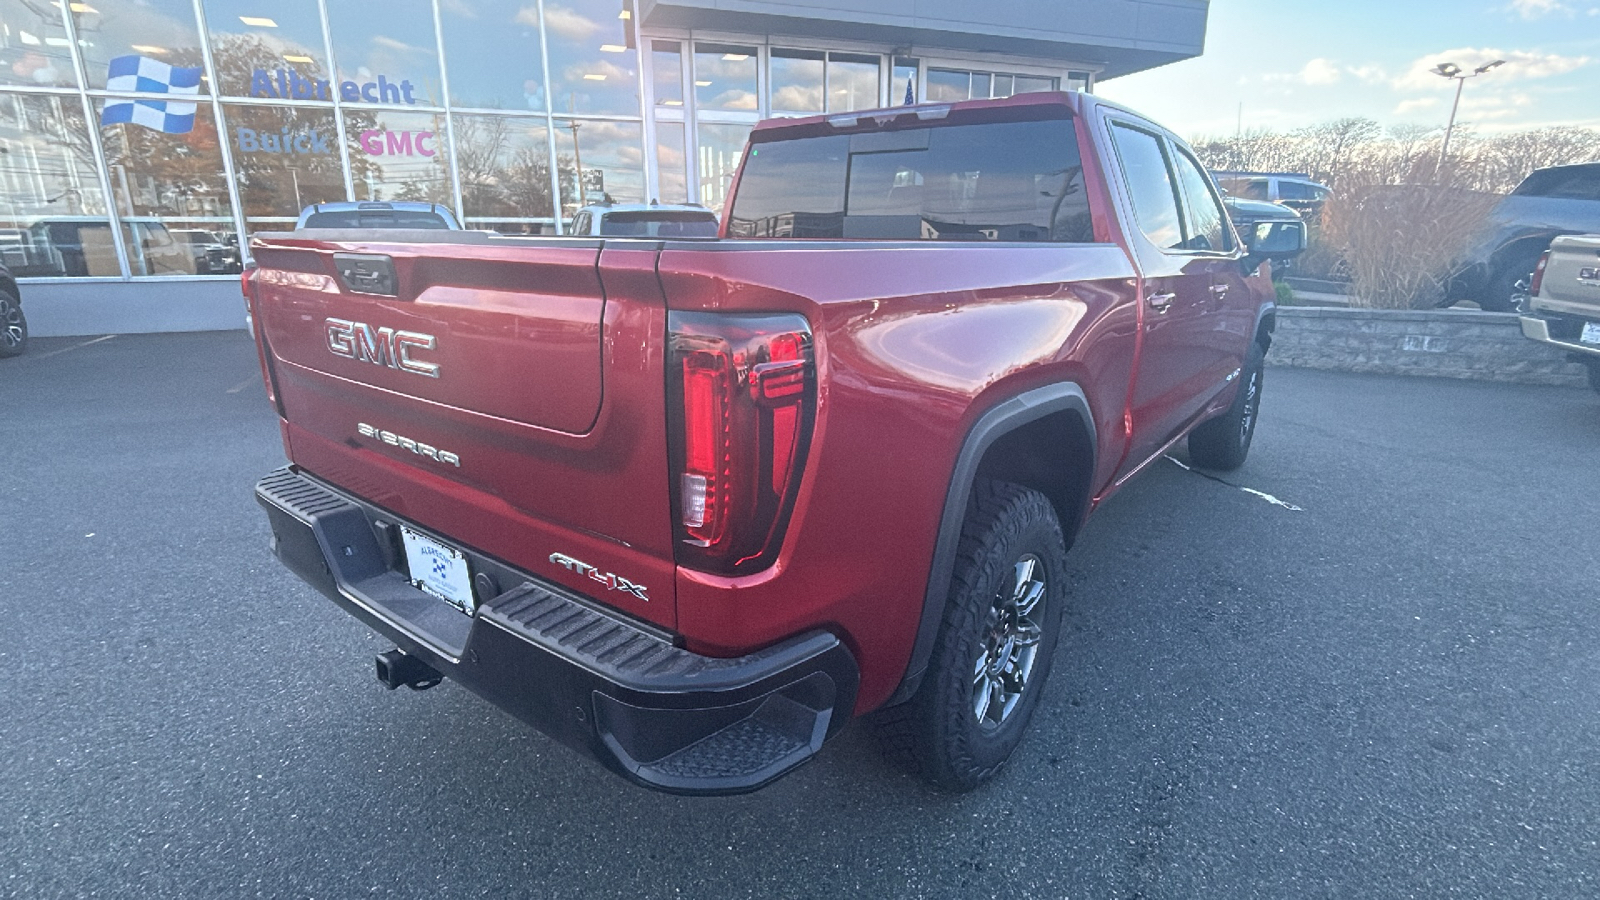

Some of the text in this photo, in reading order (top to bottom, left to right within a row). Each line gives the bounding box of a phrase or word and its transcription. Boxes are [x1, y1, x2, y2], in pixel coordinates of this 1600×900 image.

[251, 68, 416, 104] Albrecht
[236, 126, 437, 158] Buick GMC
[323, 316, 440, 378] GMC
[357, 422, 460, 468] SIERRA
[549, 552, 649, 602] AT4X
